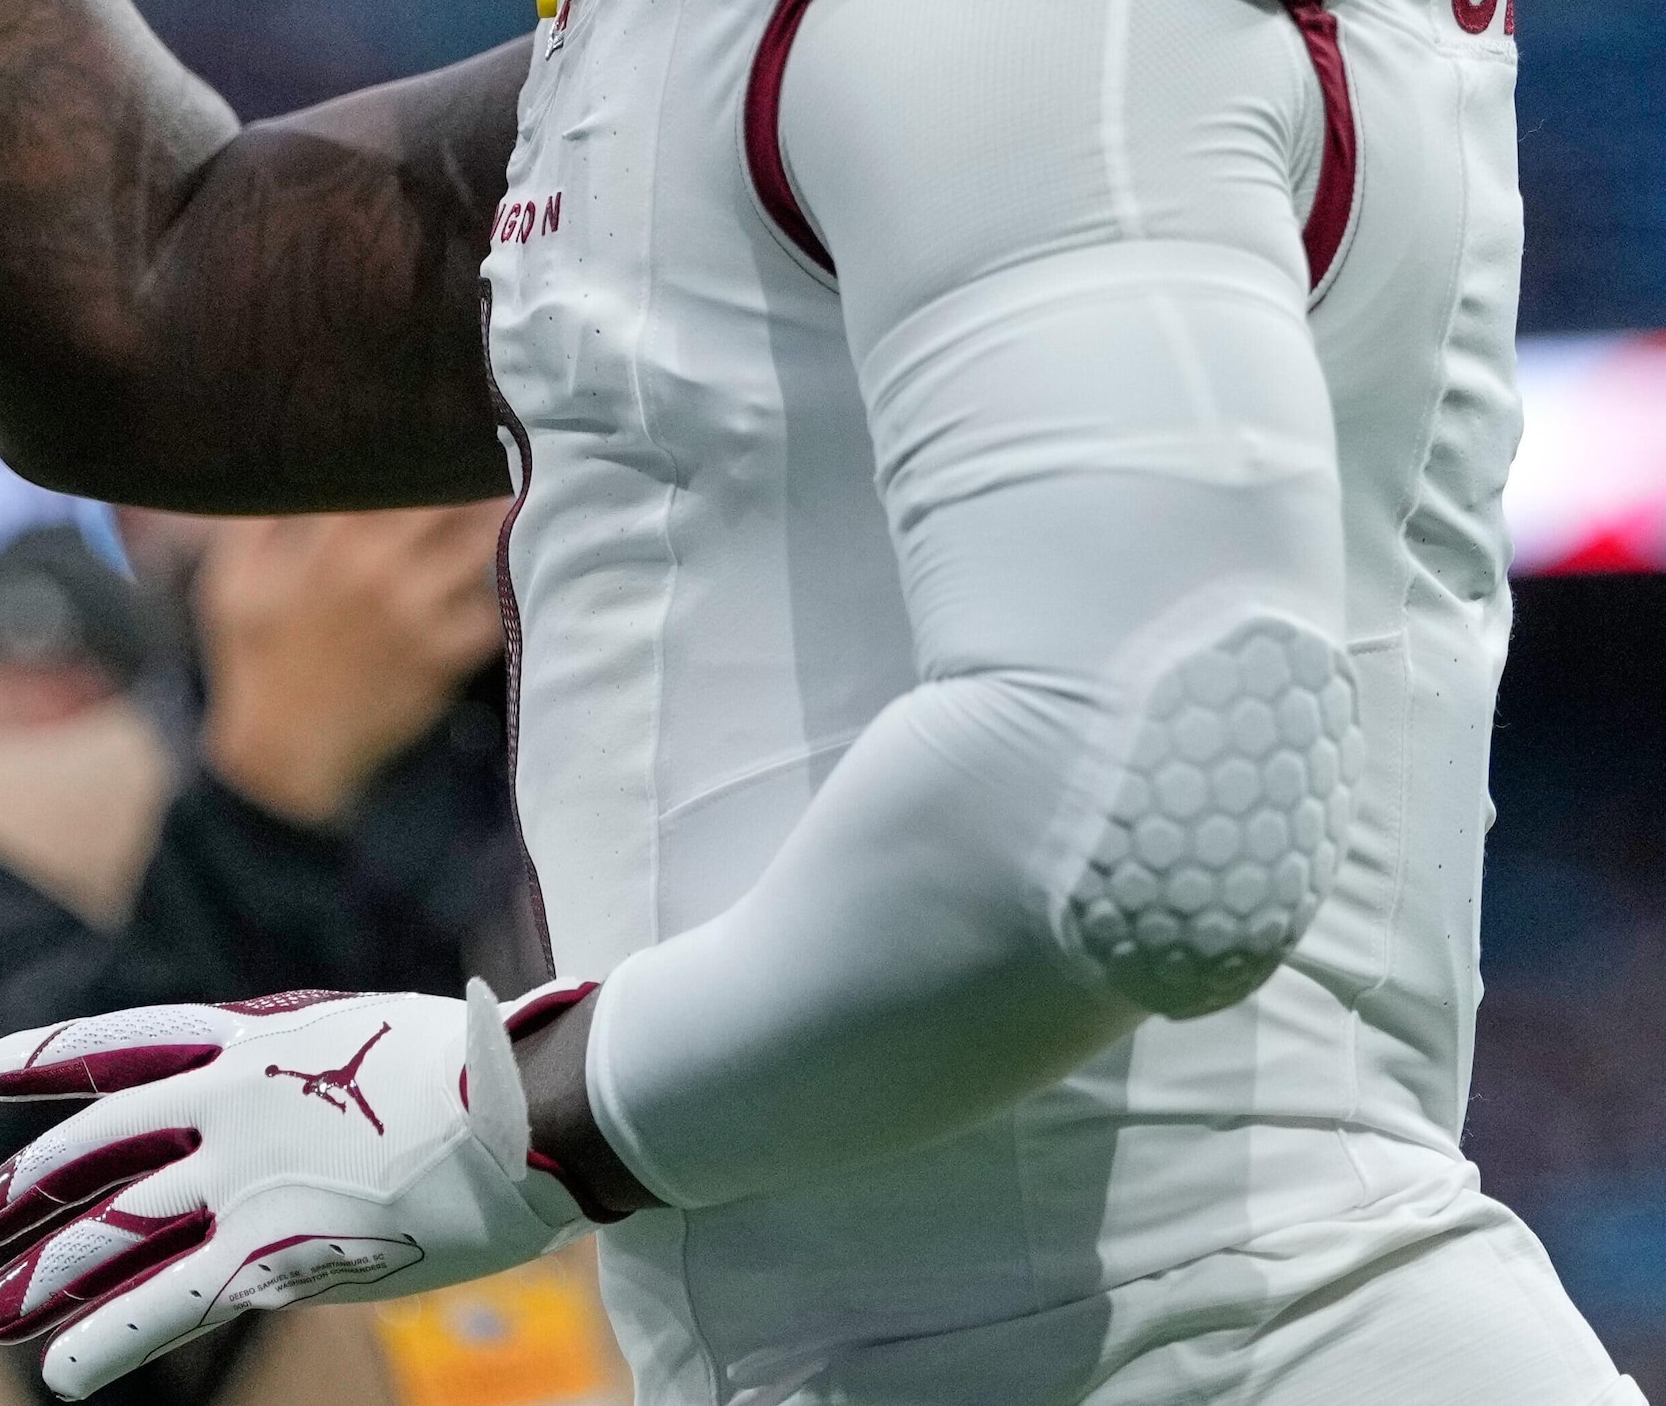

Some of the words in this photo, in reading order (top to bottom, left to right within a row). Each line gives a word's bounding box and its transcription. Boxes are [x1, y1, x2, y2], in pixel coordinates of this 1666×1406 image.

[228, 1287, 256, 1302] DEEBO
[256, 1273, 289, 1292] SAMUEL
[275, 1271, 328, 1292] WASHINGTON
[329, 1261, 388, 1275] COMMANDERS
